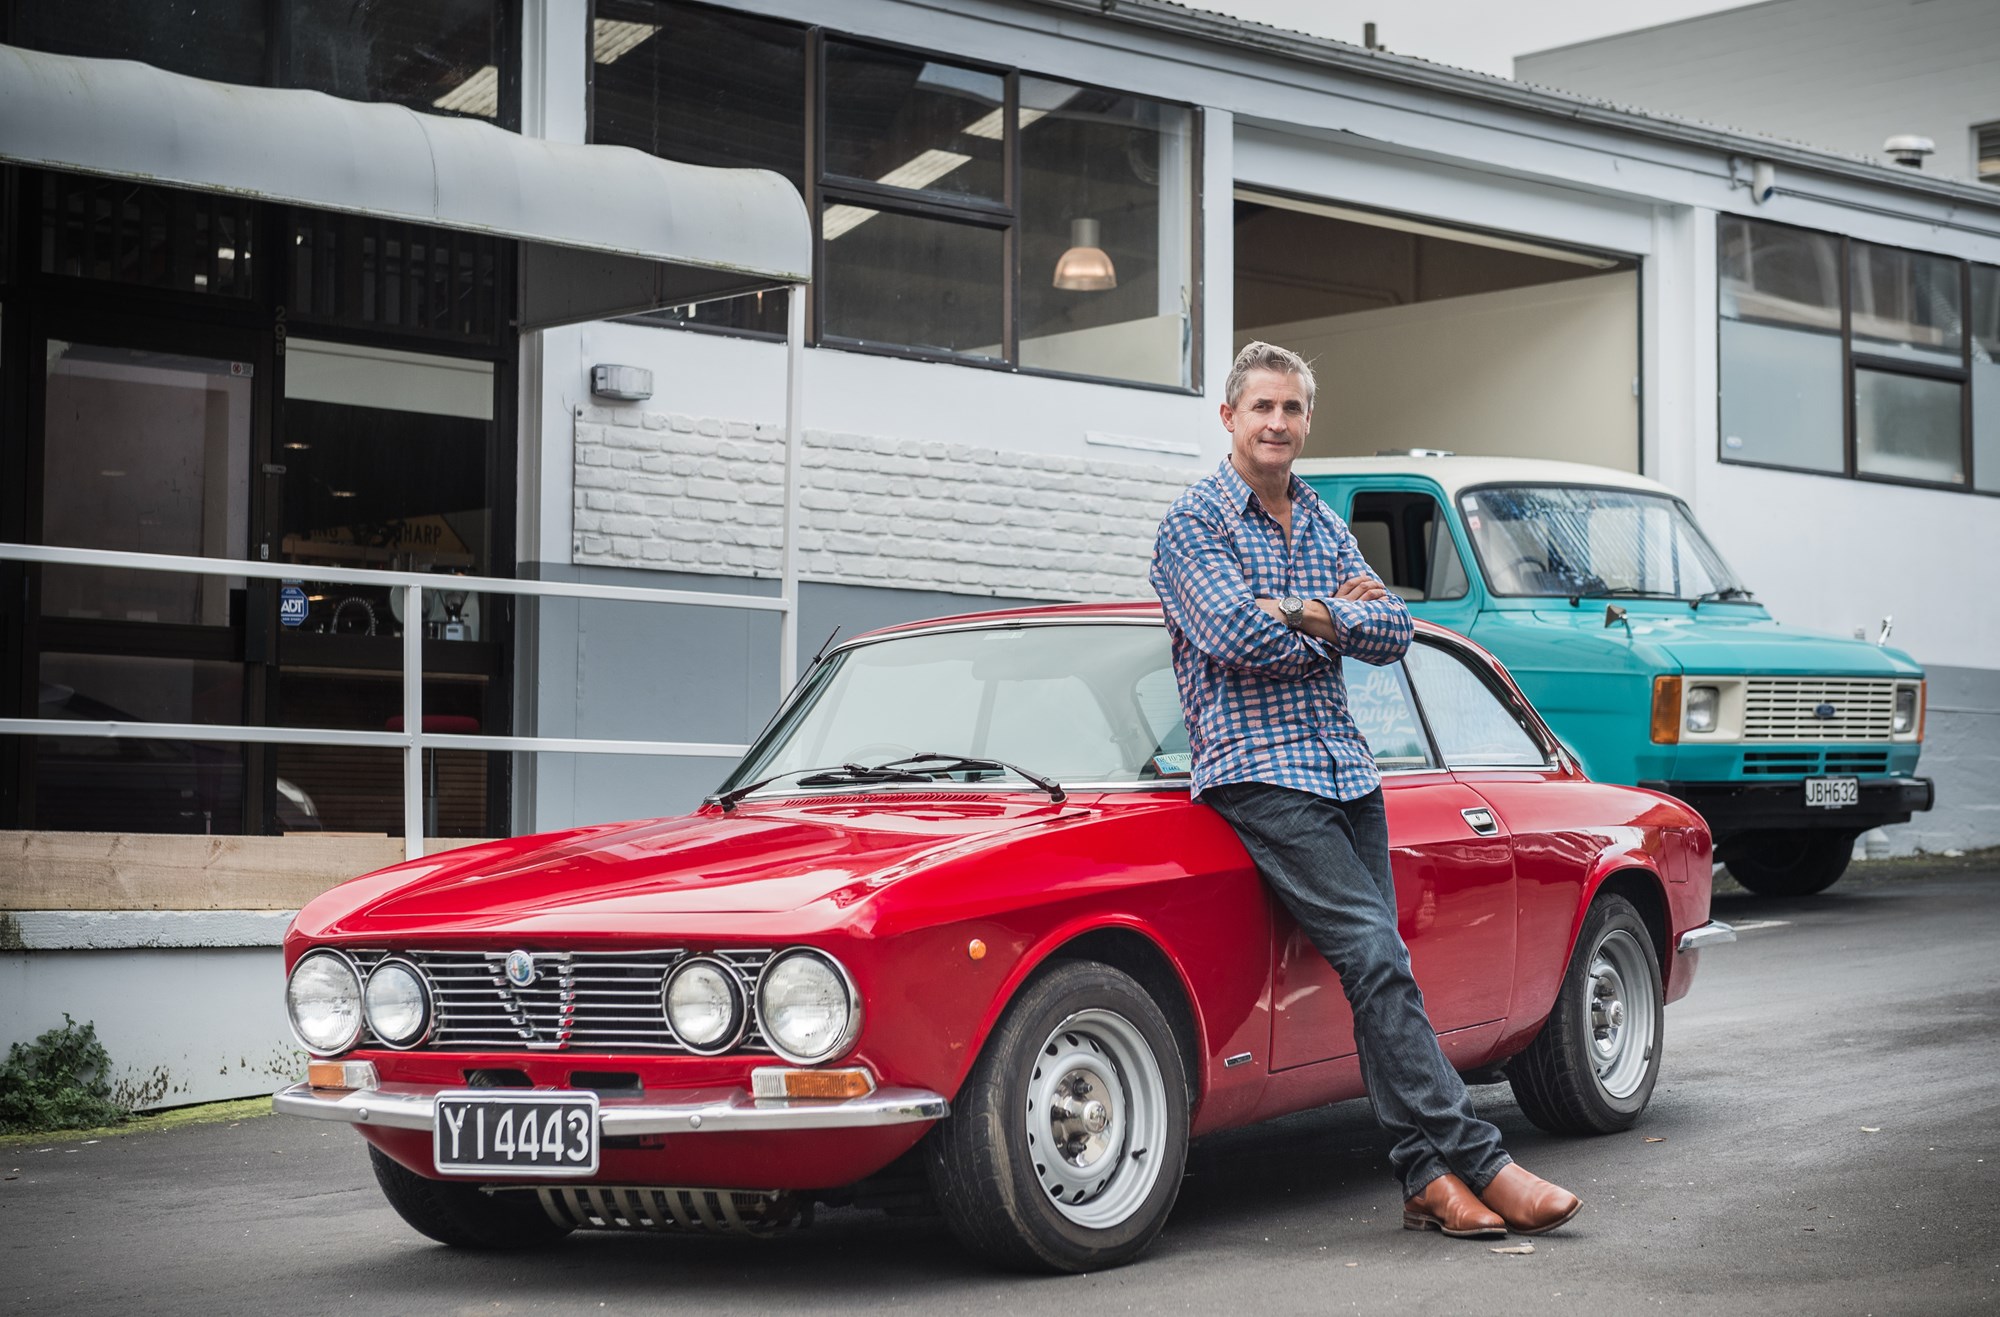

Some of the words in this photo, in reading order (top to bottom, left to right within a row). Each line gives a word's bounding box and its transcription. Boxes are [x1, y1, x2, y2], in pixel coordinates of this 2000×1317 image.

[281, 599, 304, 614] ADT
[1806, 782, 1857, 803] JBH632
[443, 1107, 589, 1162] Y14443
